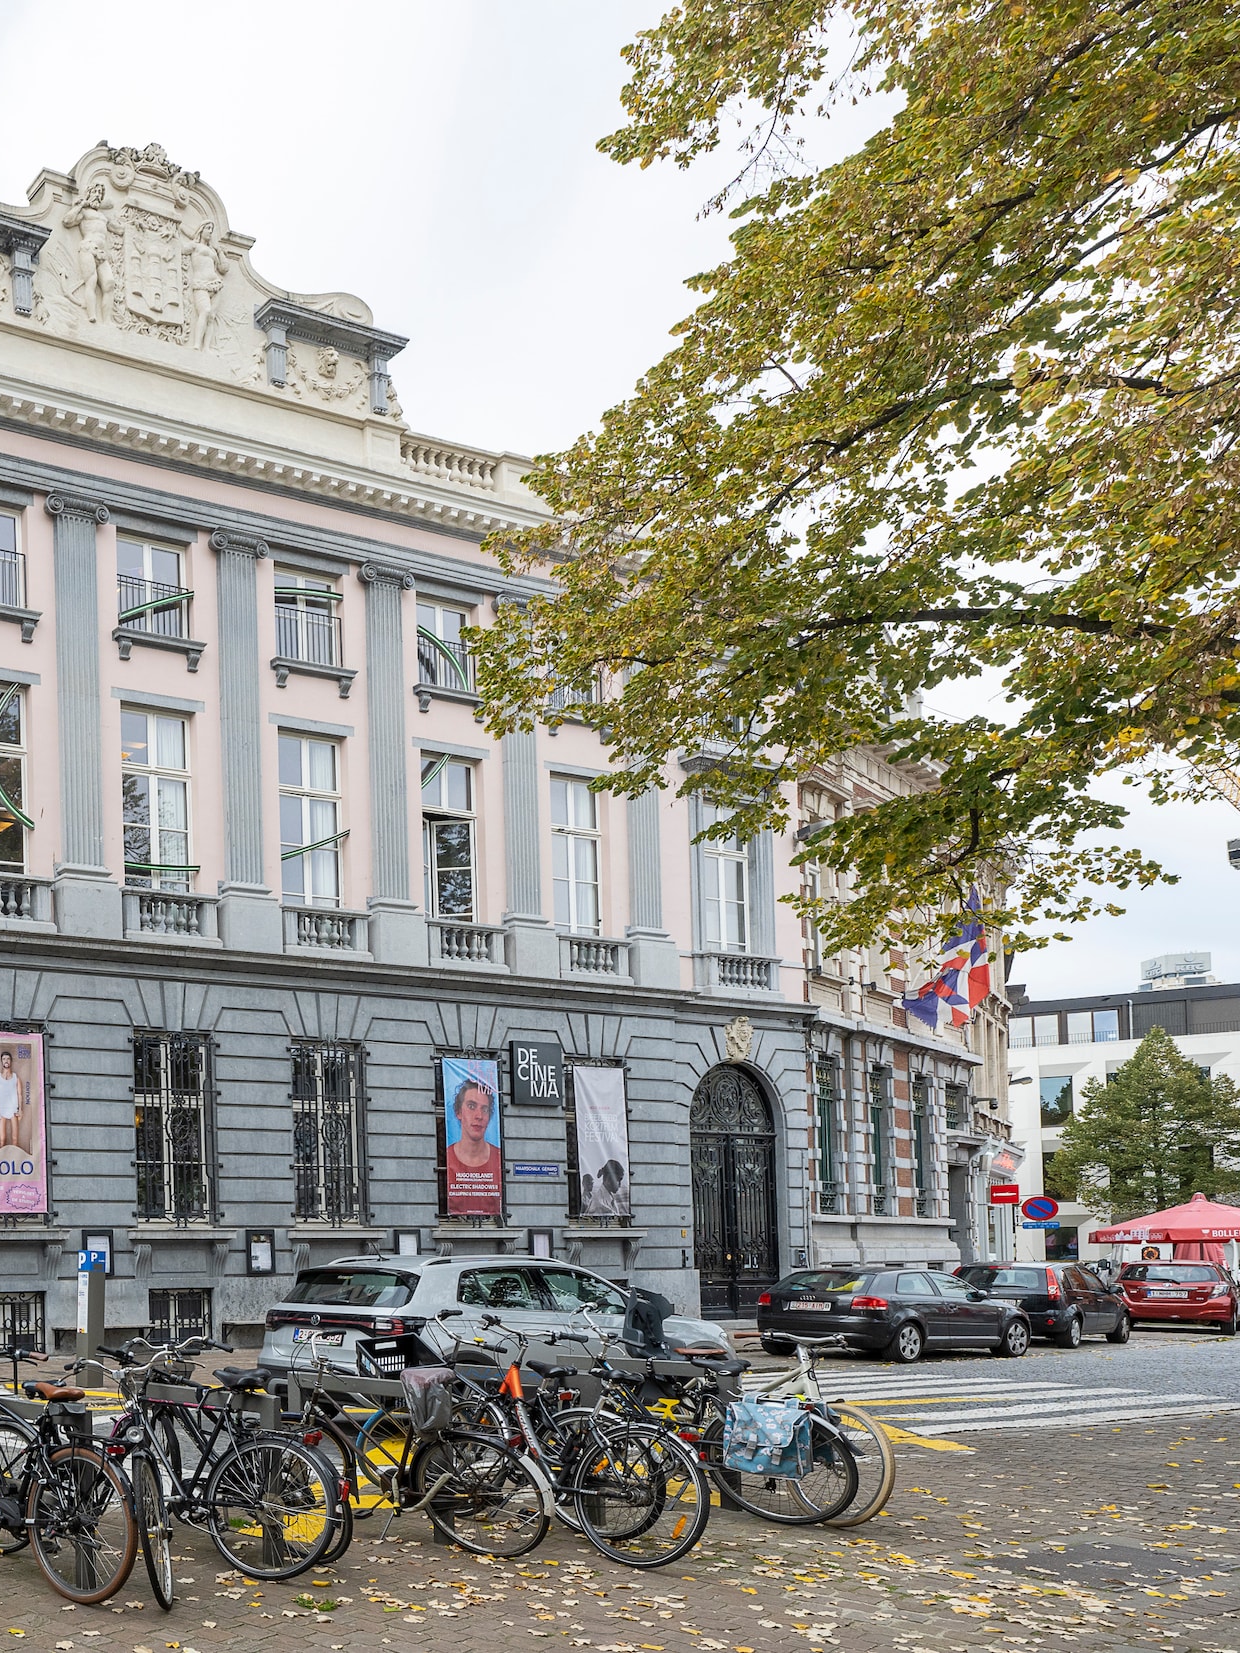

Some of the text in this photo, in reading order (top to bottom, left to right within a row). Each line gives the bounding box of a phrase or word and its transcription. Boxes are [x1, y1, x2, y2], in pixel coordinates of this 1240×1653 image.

[517, 1047, 538, 1065] DE
[517, 1064, 556, 1082] CINE
[530, 1080, 560, 1098] MA
[585, 1132, 619, 1143] FESTIVAL
[1212, 1229, 1240, 1238] BOLLE
[78, 1251, 86, 1269] P
[90, 1252, 98, 1262] P
